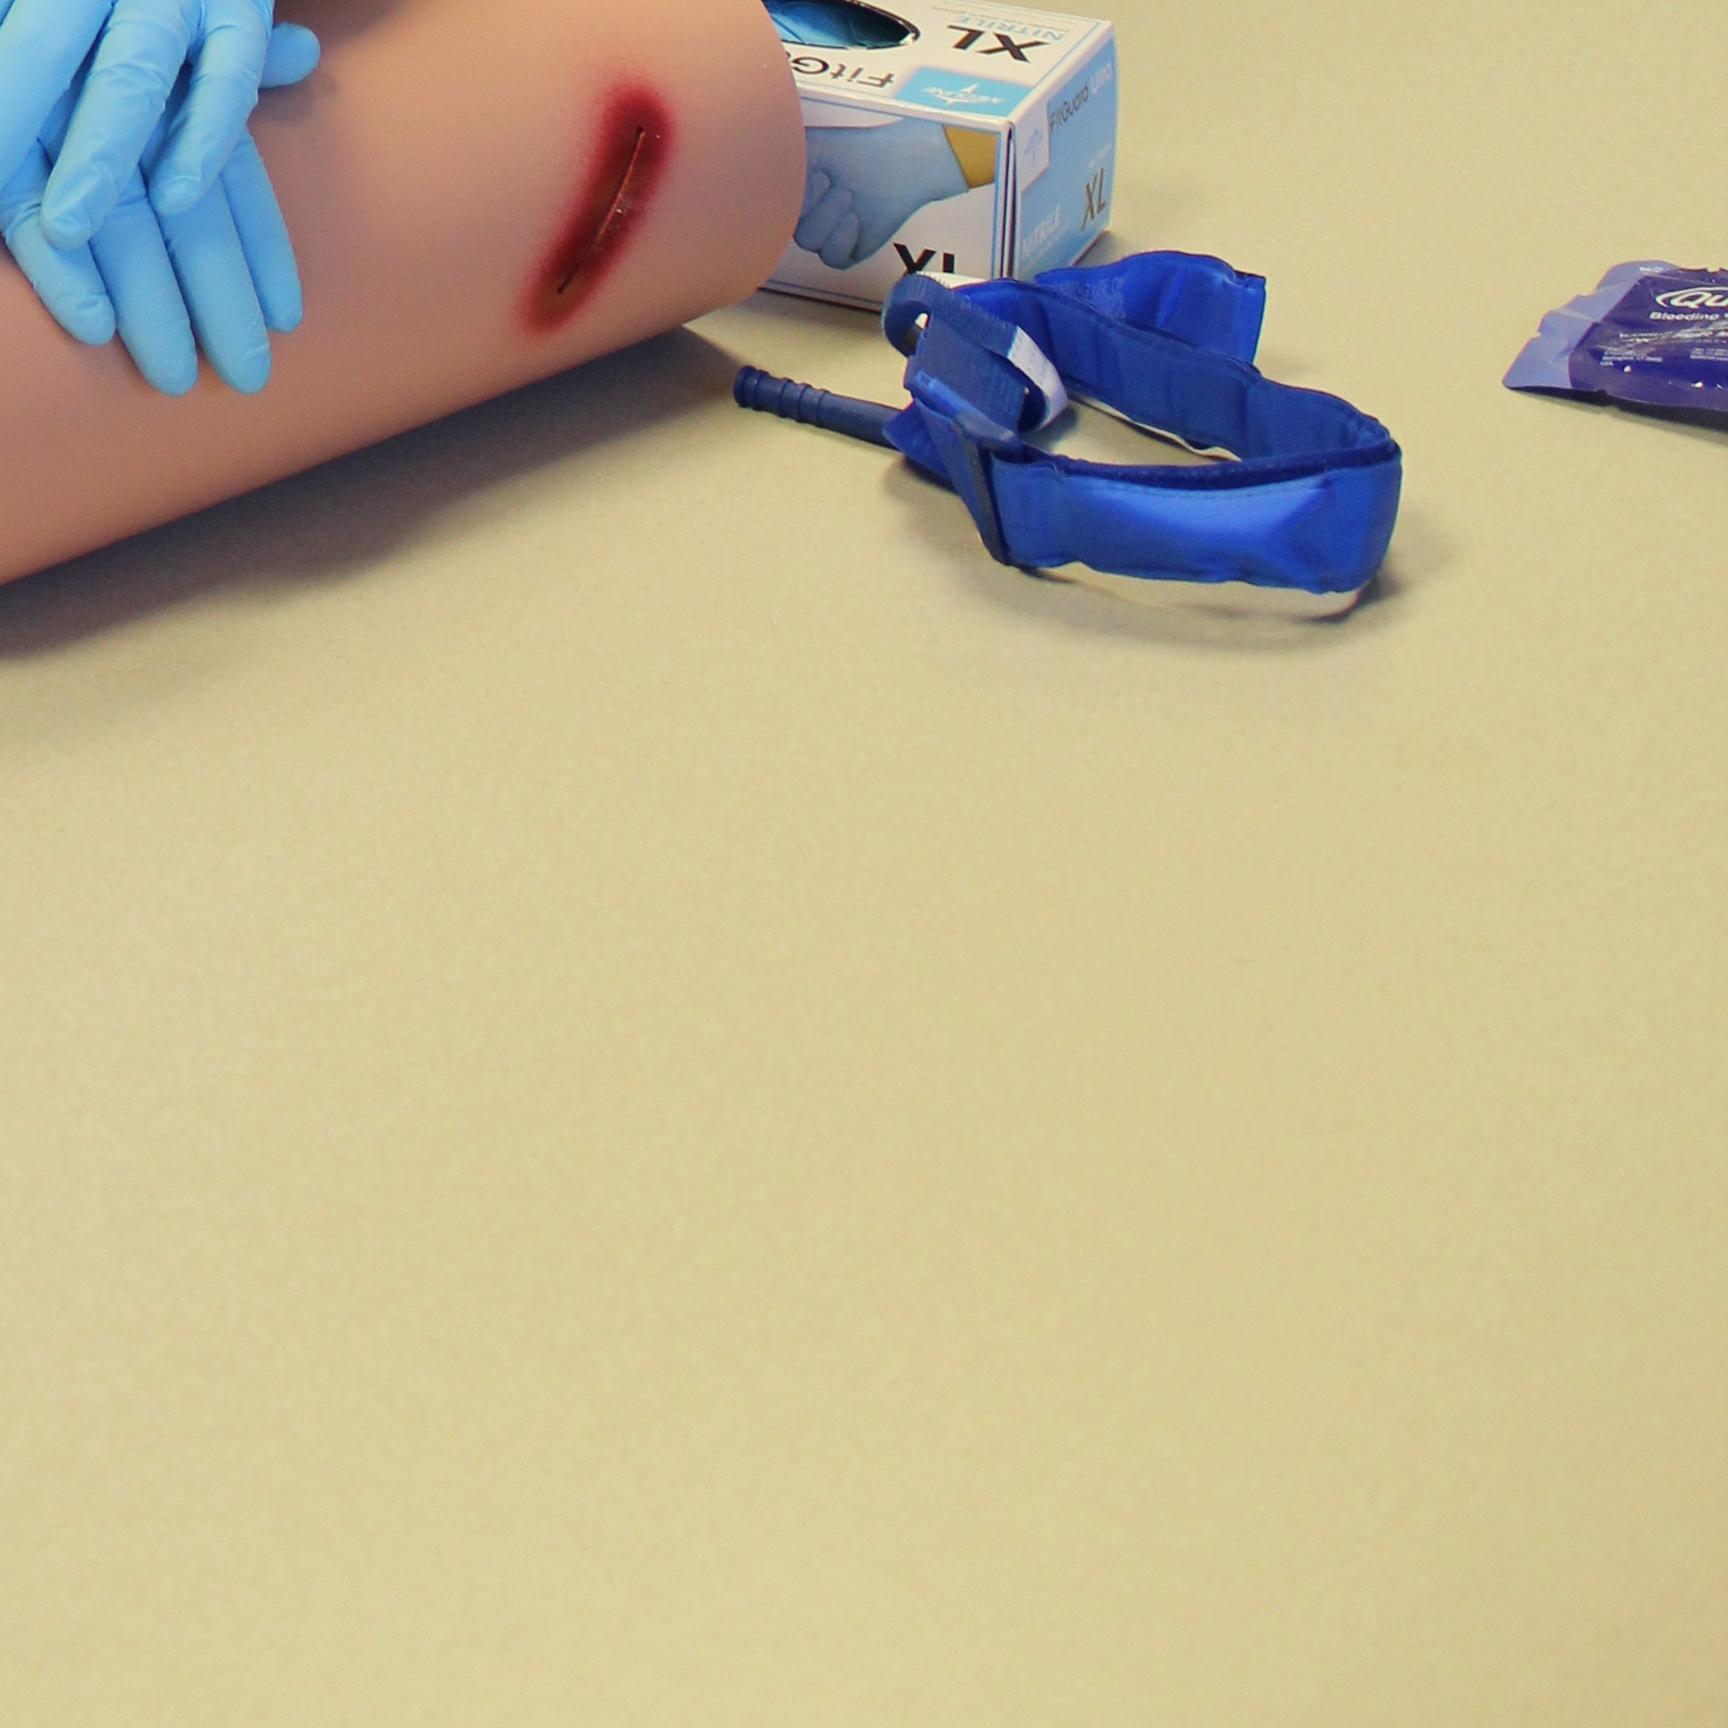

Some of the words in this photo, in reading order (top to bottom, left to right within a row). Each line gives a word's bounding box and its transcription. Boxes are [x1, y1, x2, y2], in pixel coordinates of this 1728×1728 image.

[947, 24, 1051, 64] XL
[955, 15, 1064, 42] NITRILE
[785, 52, 895, 89] FitG
[1080, 167, 1106, 232] XL
